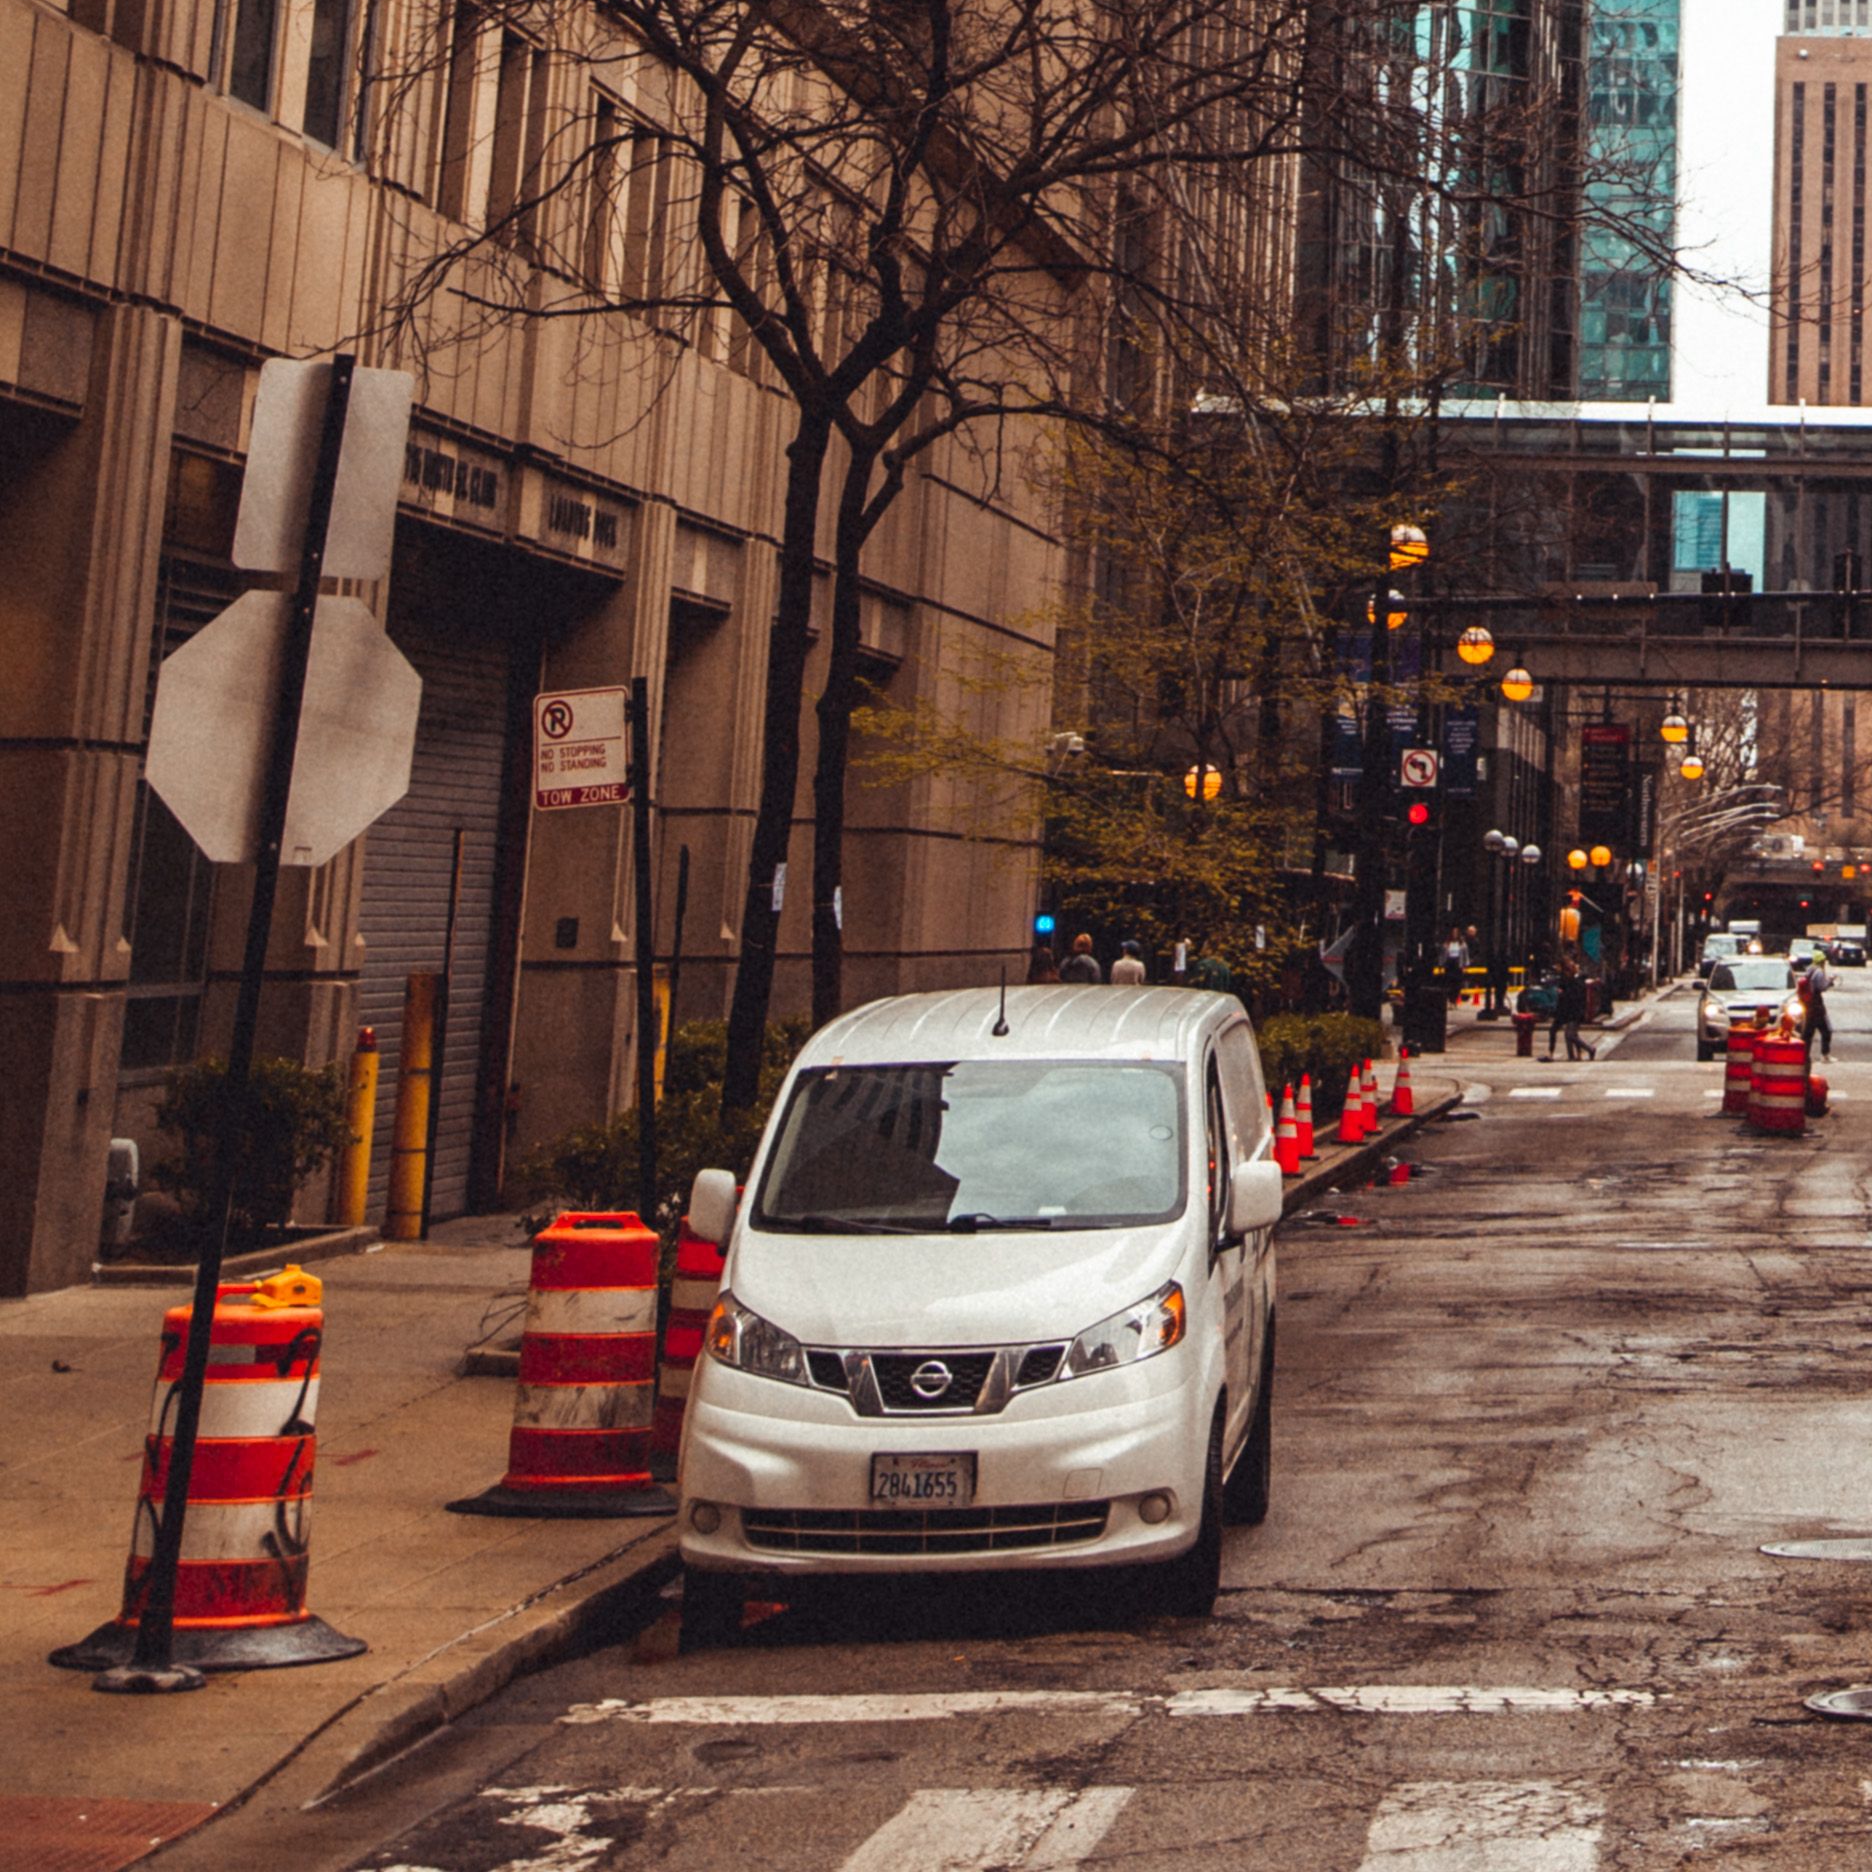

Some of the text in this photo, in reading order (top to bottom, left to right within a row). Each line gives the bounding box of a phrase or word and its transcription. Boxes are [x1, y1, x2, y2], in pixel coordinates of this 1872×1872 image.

[540, 743, 606, 760] NO STOPPING
[540, 757, 607, 773] NO STANDING
[542, 785, 620, 805] TOW ZONE
